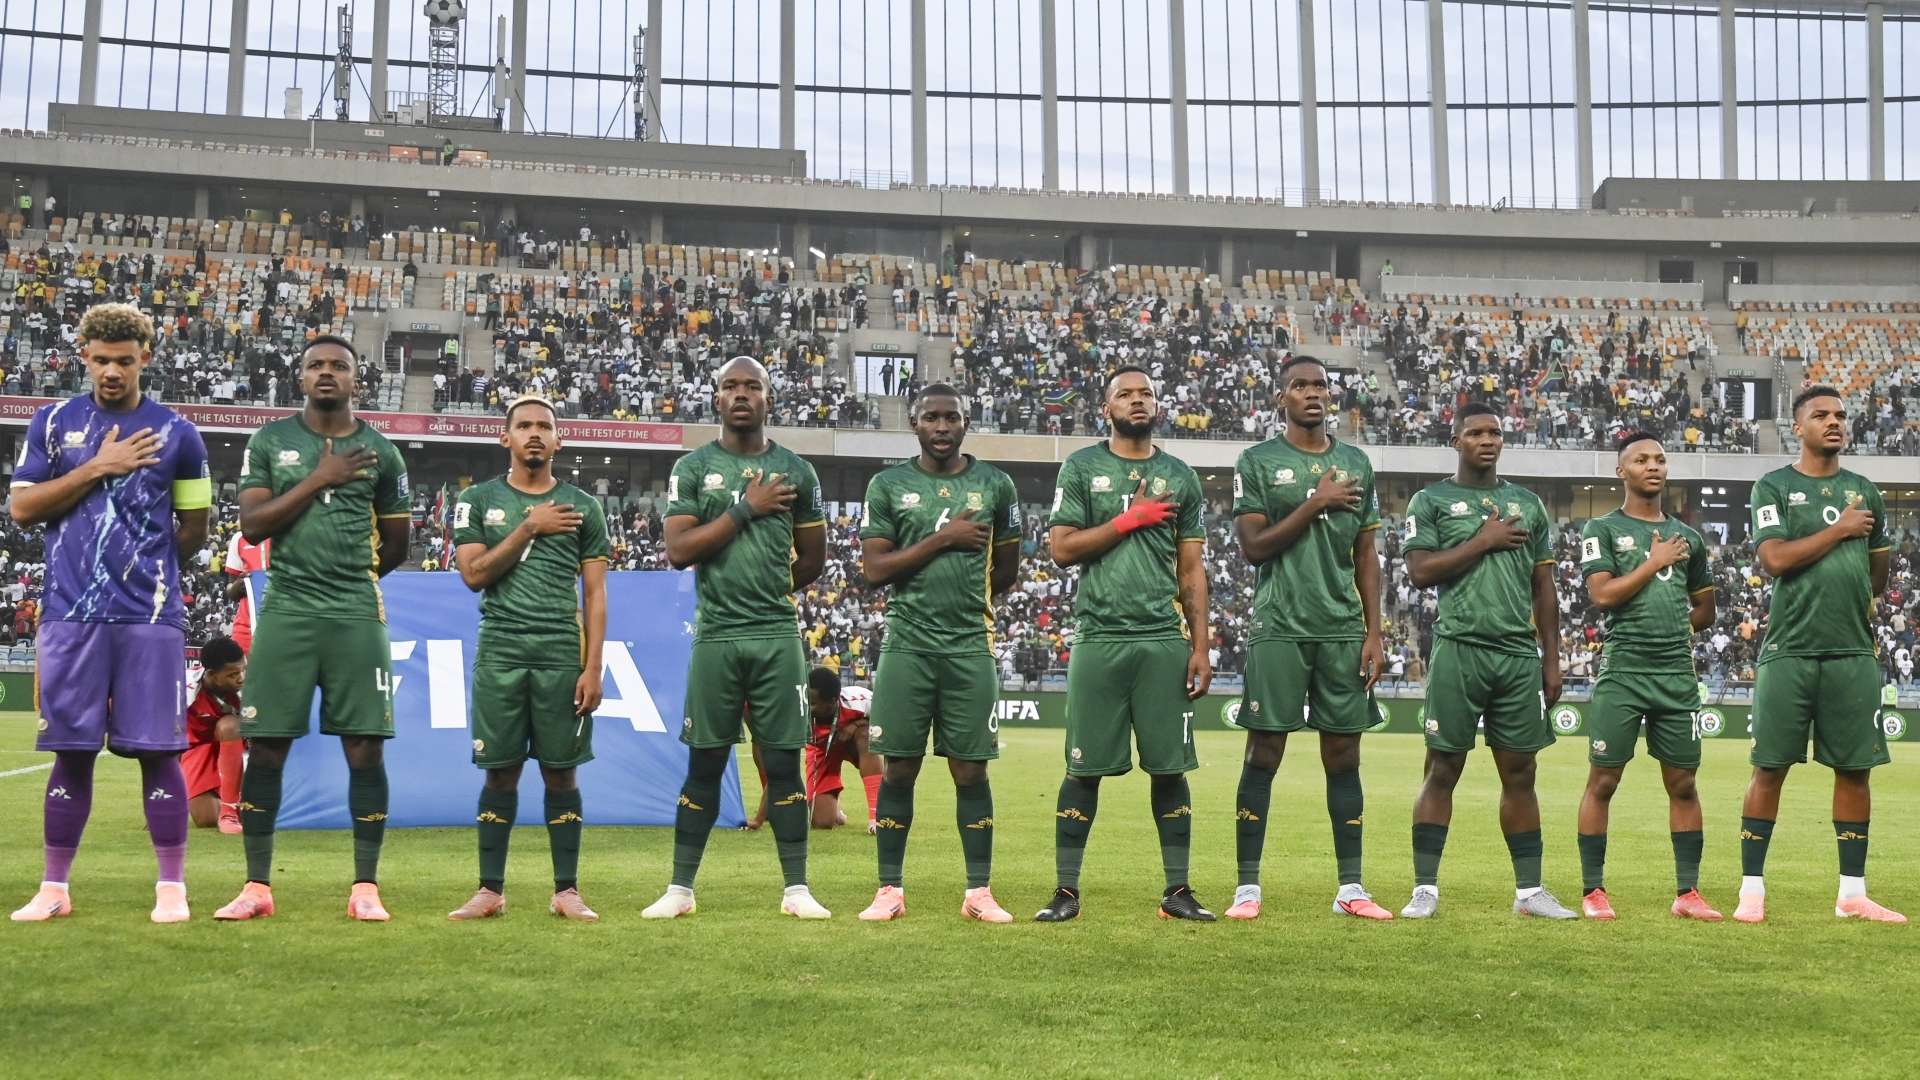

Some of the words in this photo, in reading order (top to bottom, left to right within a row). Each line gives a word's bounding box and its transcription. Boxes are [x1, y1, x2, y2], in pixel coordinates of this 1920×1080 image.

[2, 405, 35, 415] STOOD
[193, 413, 212, 422] THE
[213, 414, 242, 424] TASTE
[429, 423, 455, 431] CASTLE
[460, 424, 478, 433] THE
[479, 424, 506, 434] TASTE
[573, 427, 590, 437] THE
[592, 428, 614, 438] TEST
[615, 429, 626, 438] OF
[628, 430, 649, 440] TIME
[376, 667, 391, 701] 4
[998, 699, 1040, 720] IFA
[988, 700, 998, 733] 6
